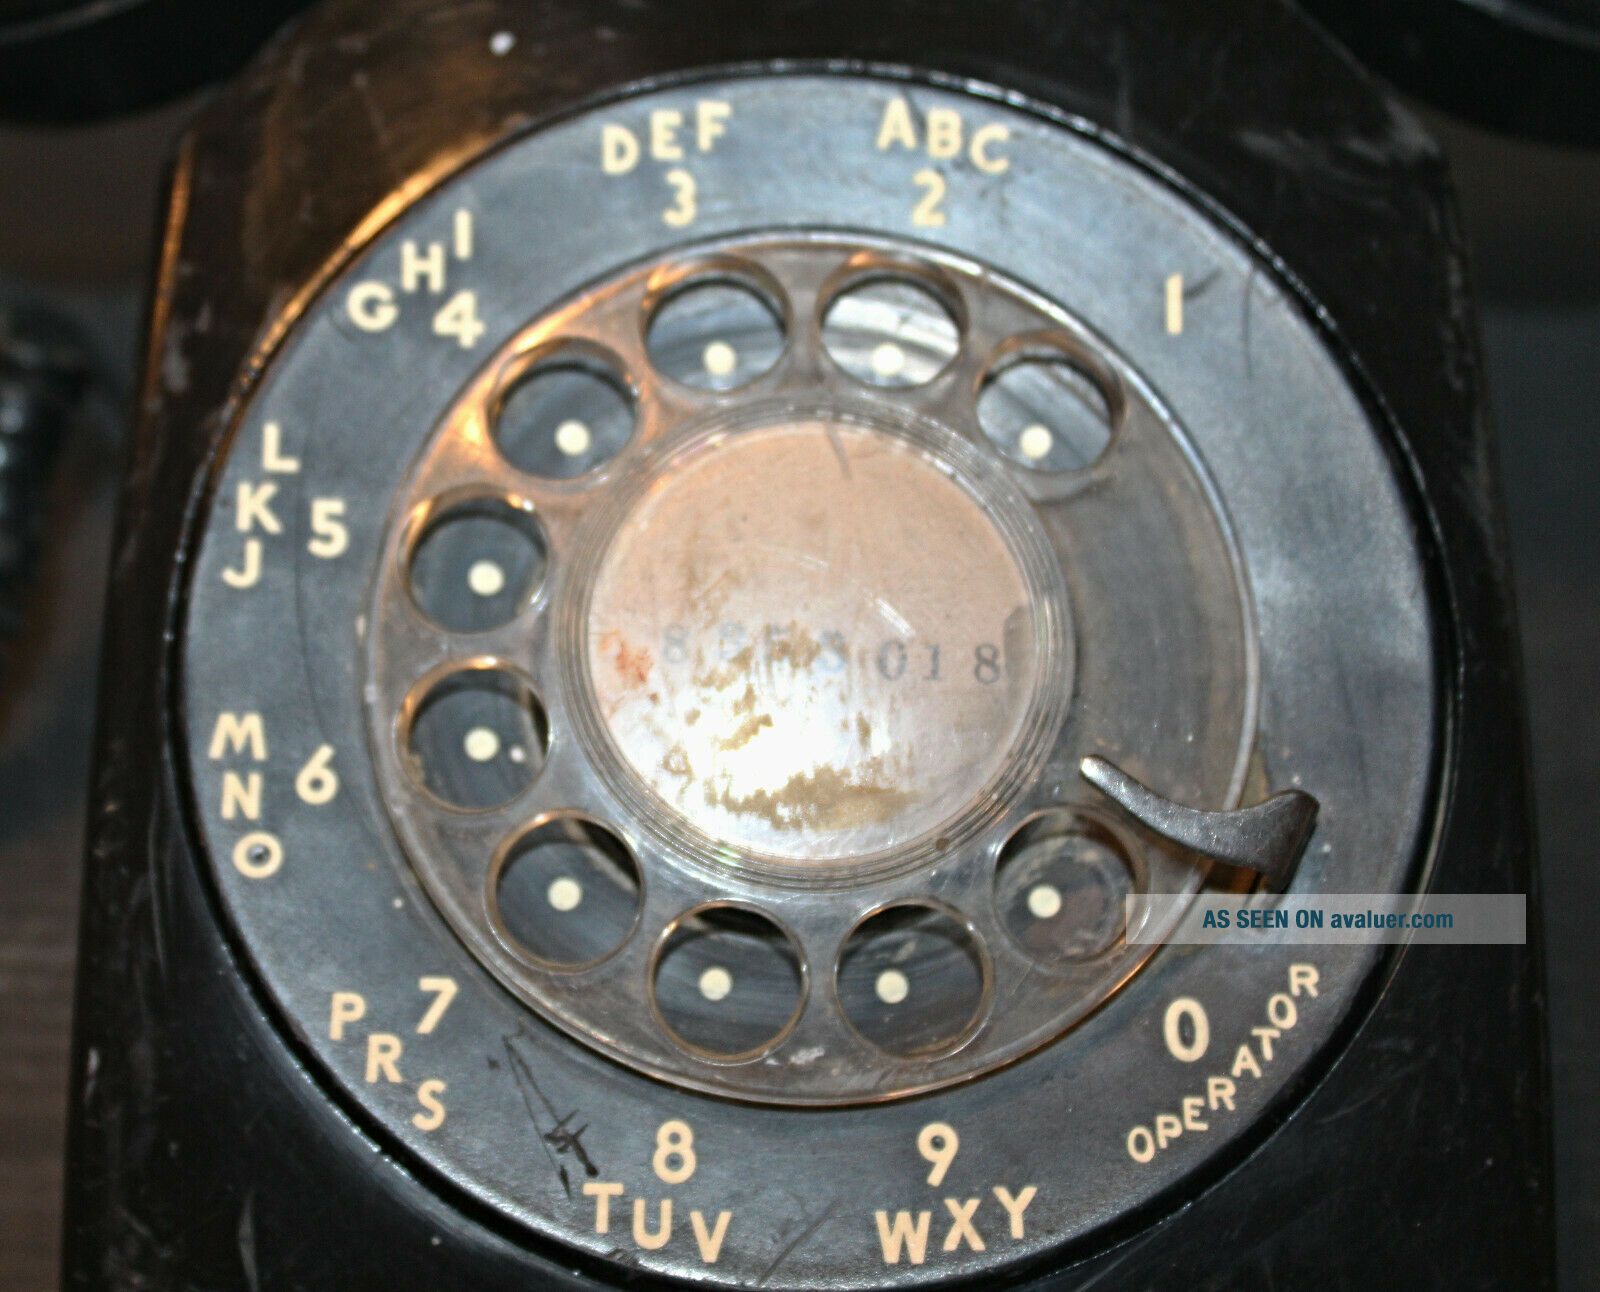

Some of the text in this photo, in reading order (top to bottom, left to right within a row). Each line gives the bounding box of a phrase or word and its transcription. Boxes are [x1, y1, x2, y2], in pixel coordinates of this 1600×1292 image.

[602, 101, 731, 175] DEF
[876, 97, 1011, 174] ABC
[663, 170, 697, 227] 3
[912, 170, 946, 227] 2
[346, 209, 474, 332] GHI
[432, 290, 485, 348] 4
[1165, 273, 1184, 335] 1
[308, 498, 348, 558] 5
[209, 712, 284, 880] MNO
[294, 745, 339, 805] 6
[415, 976, 459, 1035] 7
[1163, 997, 1210, 1063] 0
[328, 991, 446, 1131] PRS
[1127, 963, 1320, 1164] OPERATOR
[651, 1119, 698, 1185] 8
[916, 1122, 960, 1187] 9
[582, 1182, 732, 1264] TUV
[874, 1185, 1038, 1265] WXY
